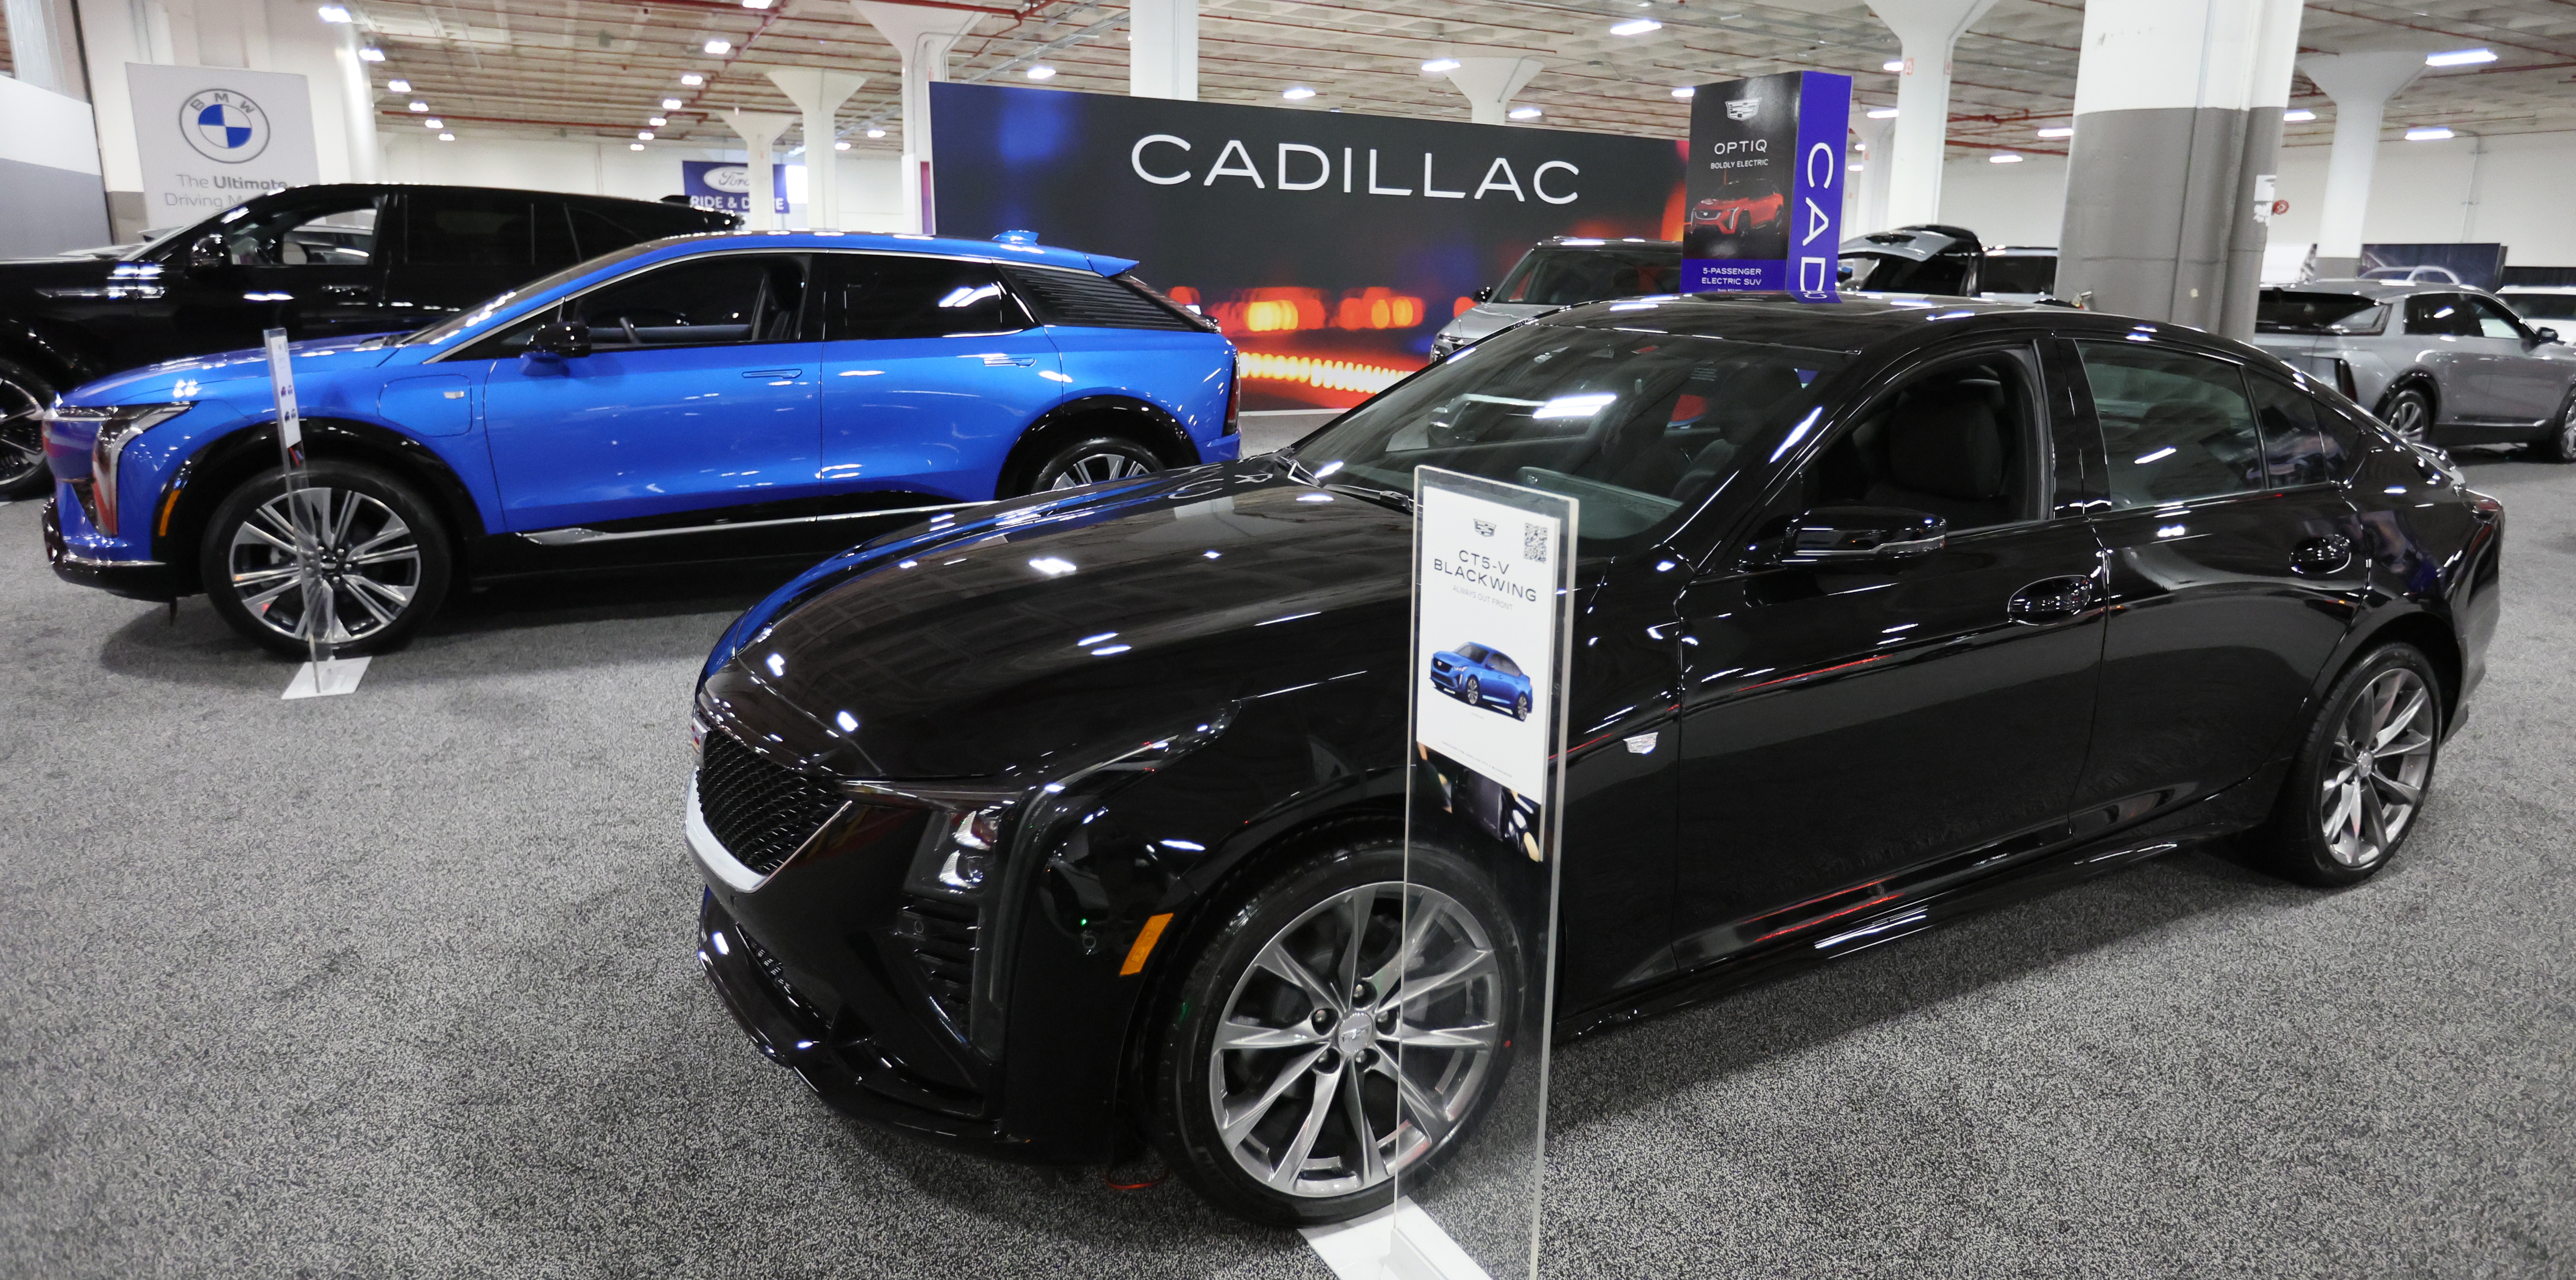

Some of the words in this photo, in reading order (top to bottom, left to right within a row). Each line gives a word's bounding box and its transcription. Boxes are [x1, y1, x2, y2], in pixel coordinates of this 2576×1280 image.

[190, 93, 255, 114] BMW
[1714, 139, 1767, 155] OPTIQ
[1131, 134, 1580, 204] CADILLAC
[1711, 161, 1736, 169] BOLDLY
[1736, 158, 1769, 168] ELECTRIC
[176, 174, 209, 188] The
[213, 176, 288, 189] Ultimate
[164, 193, 223, 210] Driving
[690, 195, 723, 208] RIDE
[728, 197, 738, 209] &
[1703, 267, 1762, 275] 5-PASSENGER
[1459, 549, 1509, 575] CT5-V
[1434, 558, 1537, 602] BLACKWING
